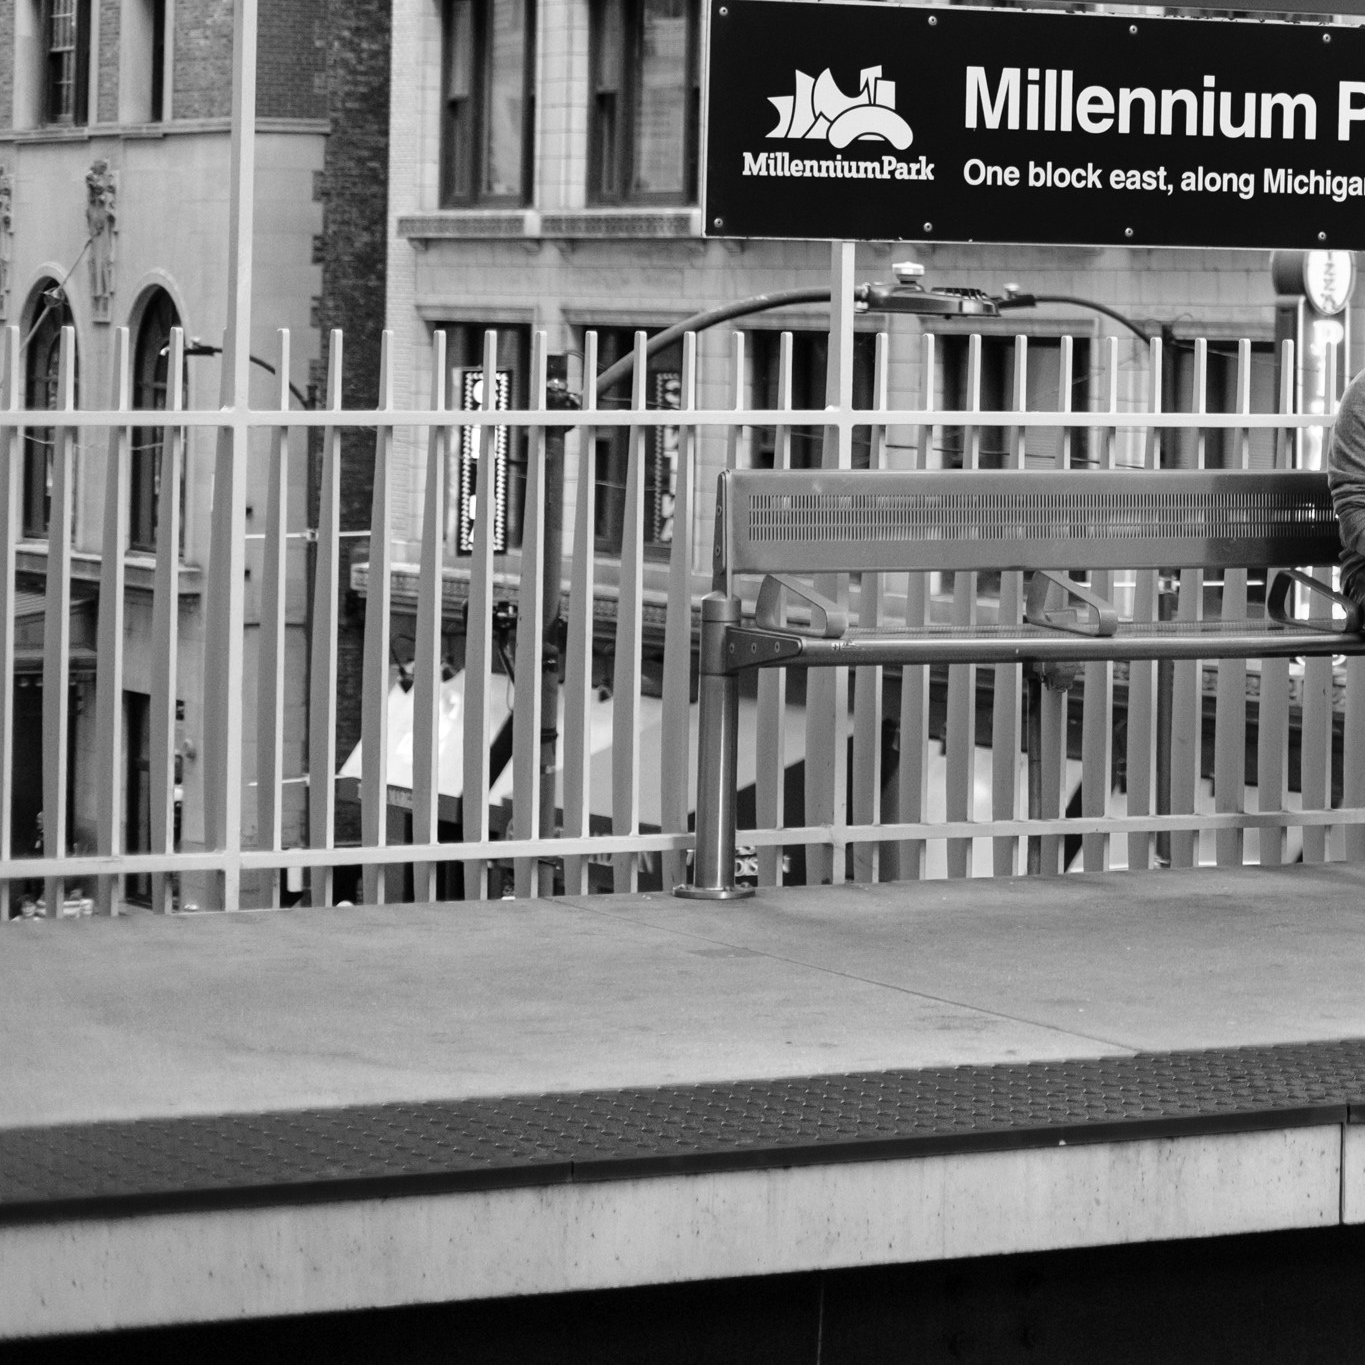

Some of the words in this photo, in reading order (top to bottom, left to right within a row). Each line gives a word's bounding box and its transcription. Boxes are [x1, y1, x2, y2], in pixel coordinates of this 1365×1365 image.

[965, 65, 1317, 140] Millennium
[742, 150, 935, 181] MillenniumPark
[963, 158, 1021, 187] One
[1028, 160, 1103, 189] block
[1109, 166, 1174, 196] east,
[1180, 165, 1255, 200] along
